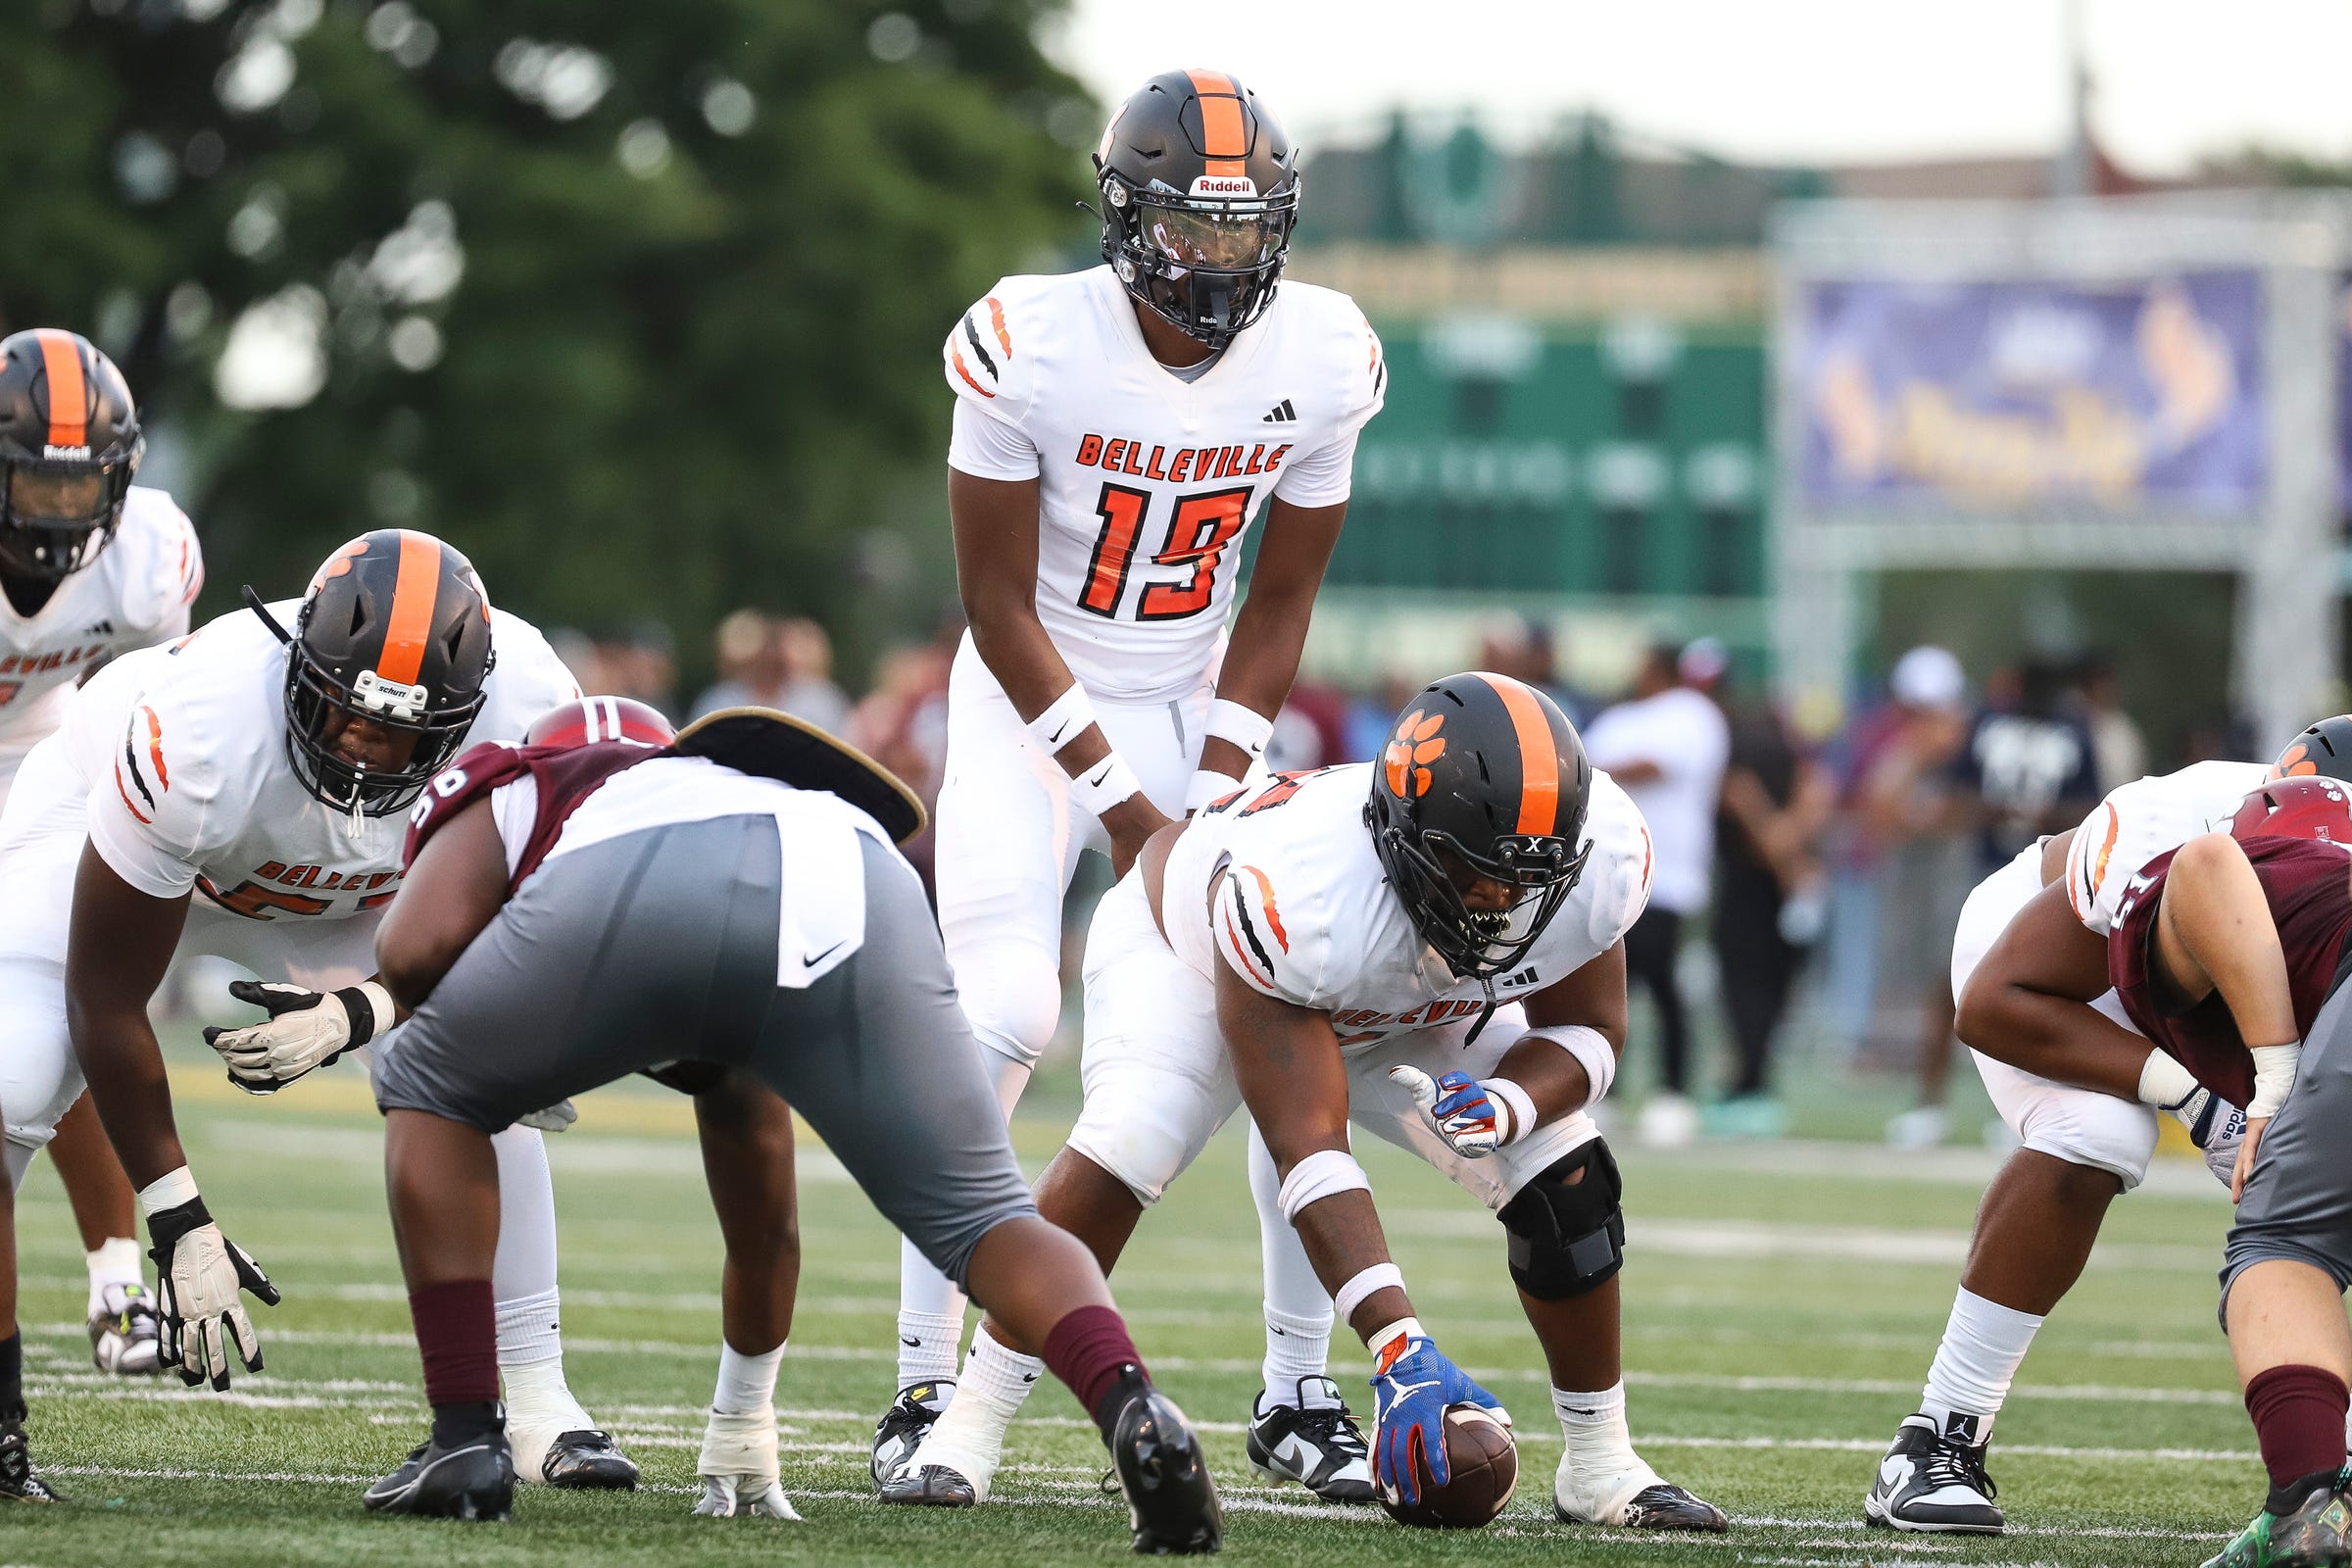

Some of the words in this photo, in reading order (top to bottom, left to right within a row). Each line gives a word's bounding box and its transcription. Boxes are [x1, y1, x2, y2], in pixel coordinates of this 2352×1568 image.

[1200, 179, 1250, 192] Riddell
[1076, 433, 1294, 483] BELLEVILLE
[1076, 481, 1255, 621] 19
[377, 685, 408, 698] schutt
[1525, 836, 1544, 853] X
[2222, 1108, 2245, 1141] idas
